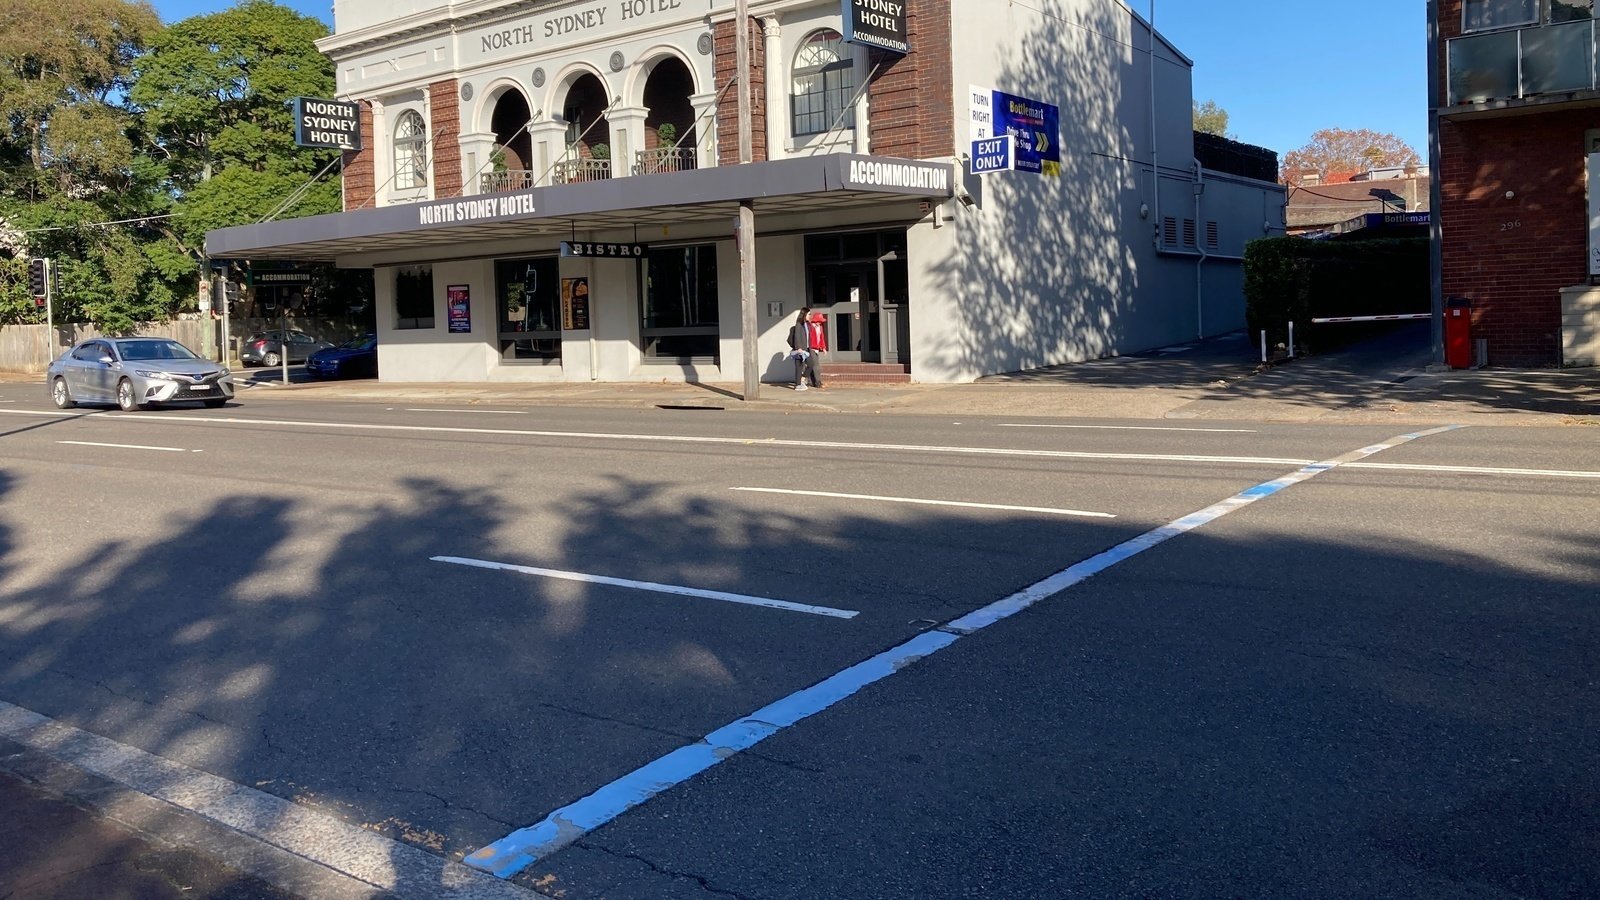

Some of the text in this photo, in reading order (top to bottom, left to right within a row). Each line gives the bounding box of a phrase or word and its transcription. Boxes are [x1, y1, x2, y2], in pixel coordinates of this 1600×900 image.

[481, 0, 681, 52] NORTH SYDNEY HOTEL
[861, 10, 898, 32] HOTEL
[853, 30, 907, 50] ACCOMMODATION
[973, 93, 989, 106] TURN
[306, 102, 353, 117] NORTH
[972, 110, 990, 123] RIGHT
[1009, 101, 1044, 120] Bottlemart
[303, 116, 356, 131] SYDNEY
[310, 131, 352, 145] HOTEL
[977, 128, 985, 138] AT
[978, 141, 1001, 155] EXIT
[976, 155, 1004, 170] ONLY
[850, 160, 947, 190] ACCOMMODATION
[419, 194, 535, 225] NORTH SYDNEY HOTEL
[1500, 219, 1521, 231] 296
[573, 243, 642, 256] BISTRO
[261, 273, 310, 281] ACCOMMODATION
